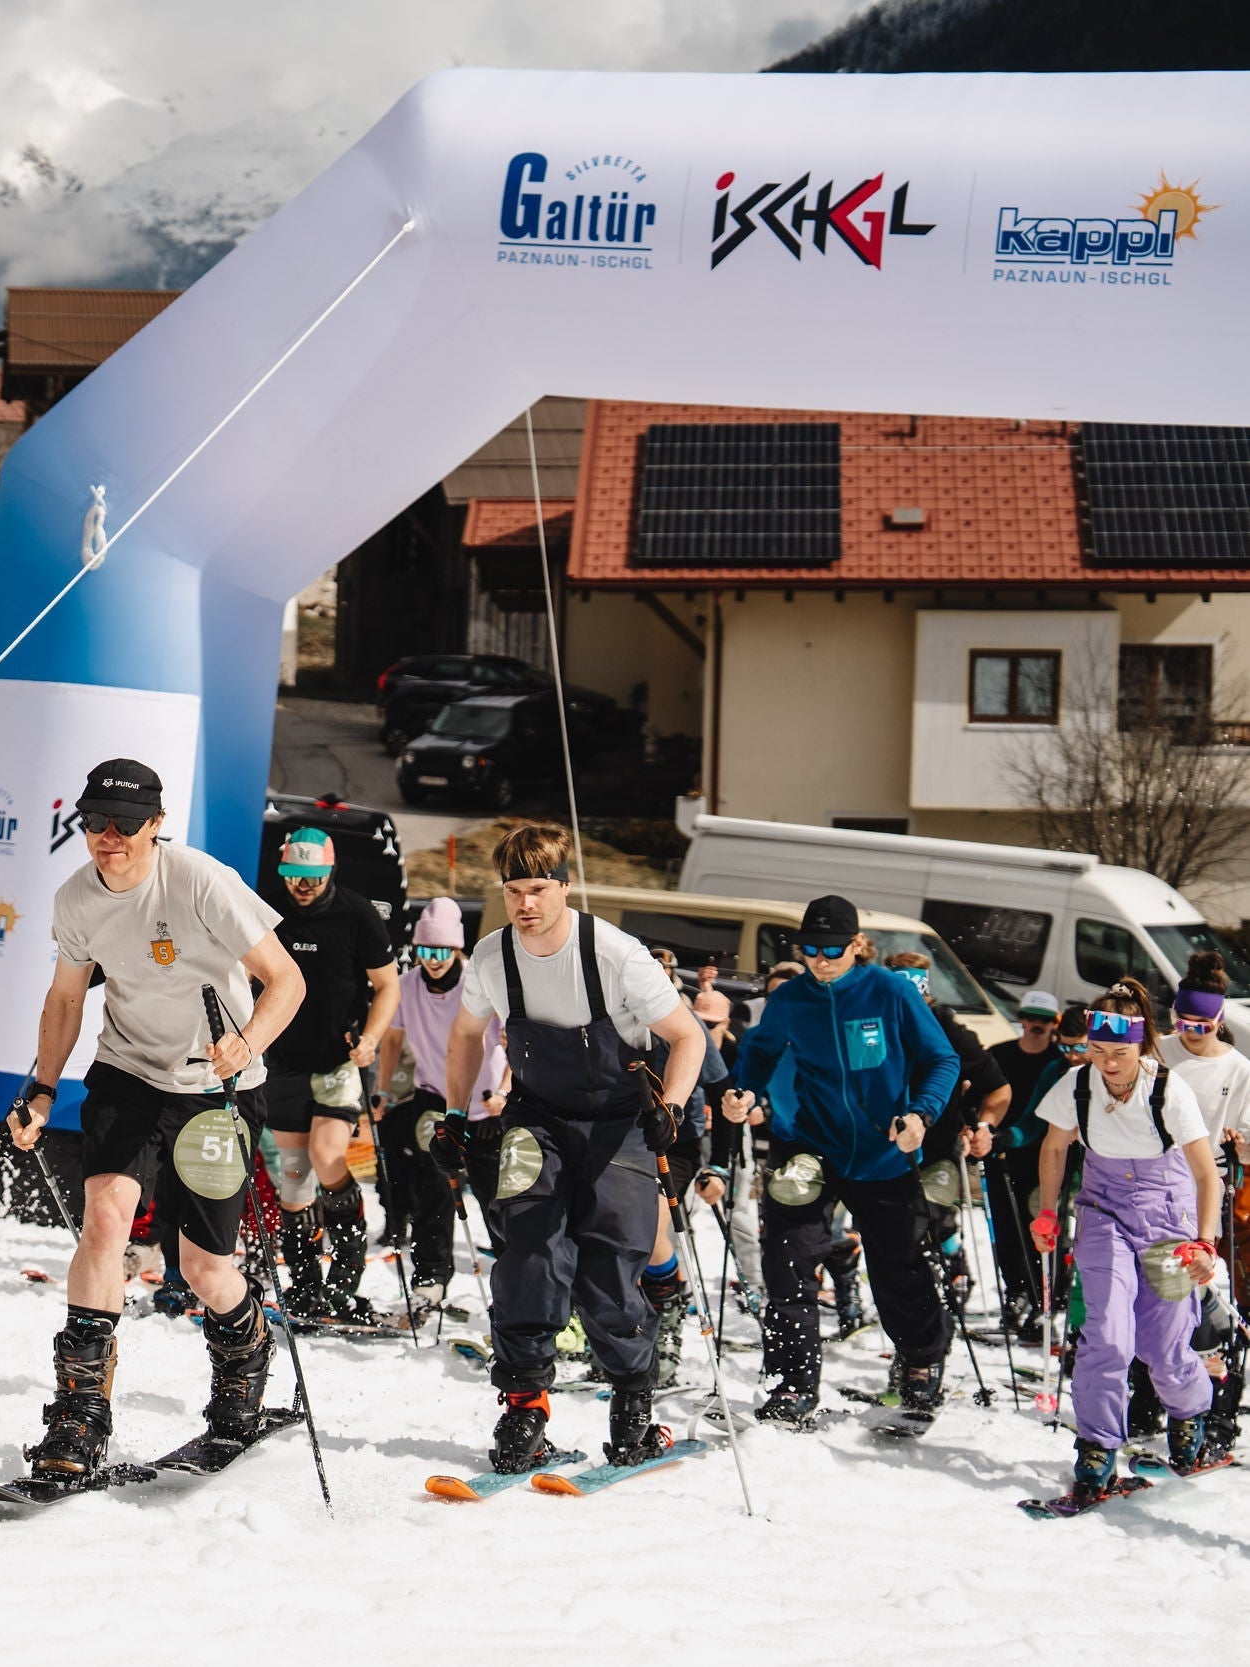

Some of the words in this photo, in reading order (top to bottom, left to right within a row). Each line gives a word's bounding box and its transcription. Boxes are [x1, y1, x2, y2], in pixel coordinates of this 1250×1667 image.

[564, 154, 647, 184] SILVRETTA
[500, 152, 656, 243] Galtür
[996, 207, 1178, 265] kappl
[496, 250, 653, 270] PAZNAUN-ISCHGL
[993, 268, 1172, 286] PAZNAUN-ISCHGL
[201, 1135, 234, 1163] 51
